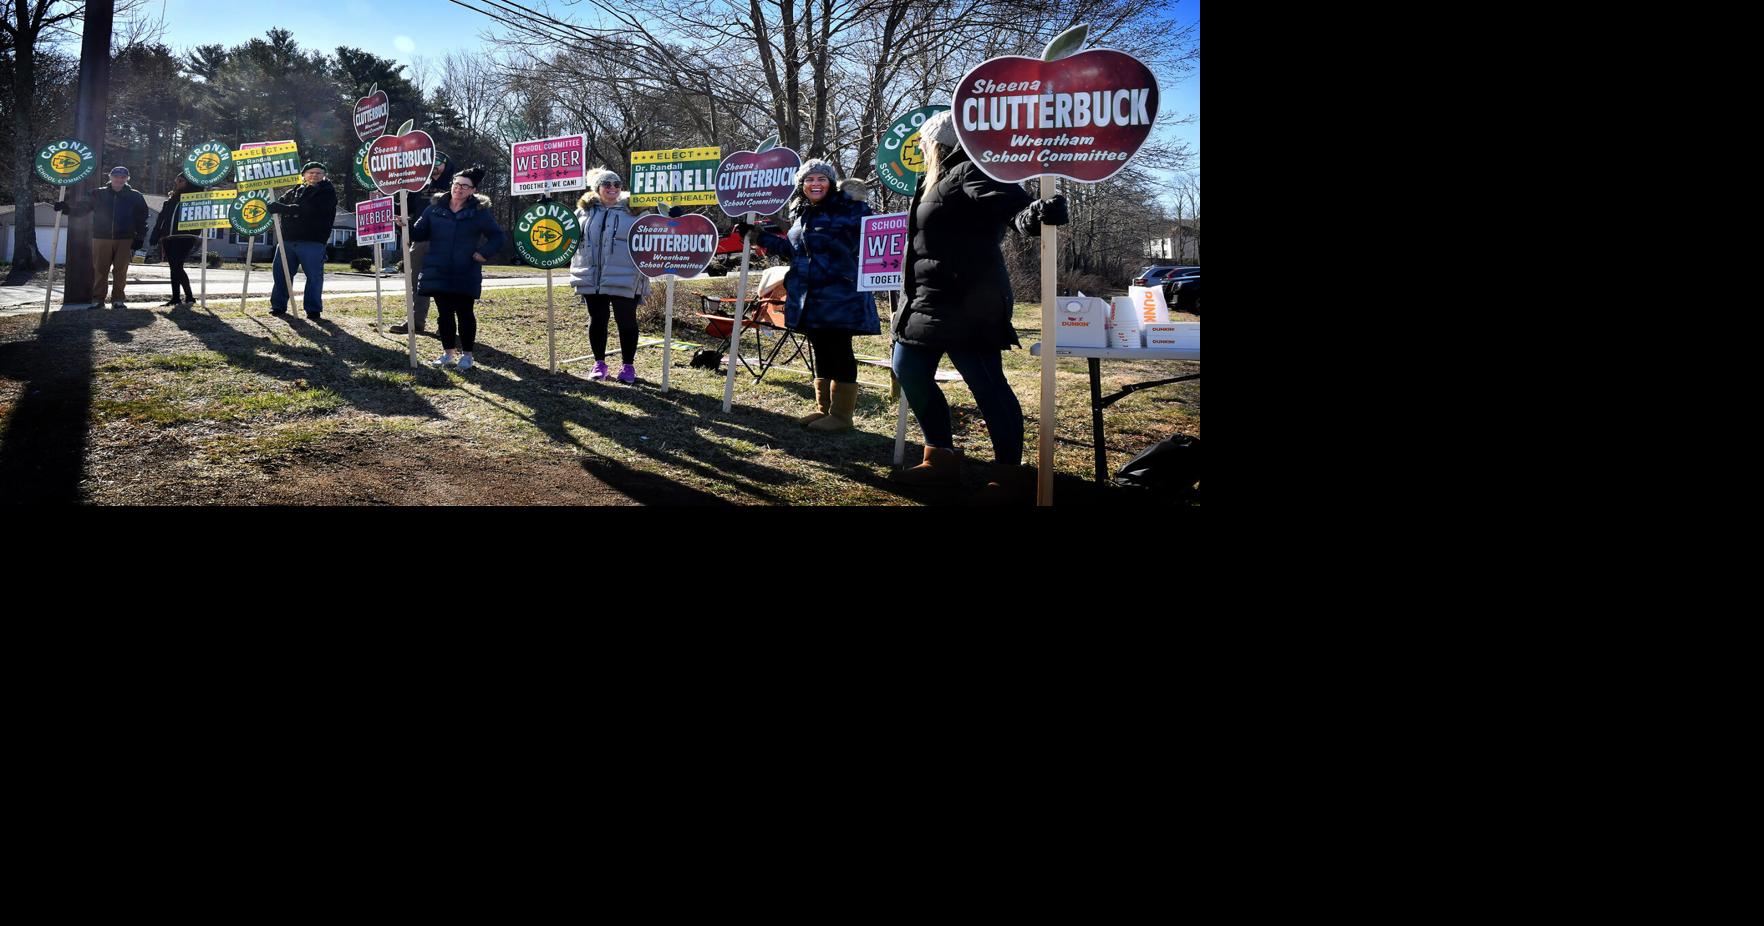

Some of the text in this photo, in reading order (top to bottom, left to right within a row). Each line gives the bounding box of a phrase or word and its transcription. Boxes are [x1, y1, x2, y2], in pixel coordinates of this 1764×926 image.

[972, 78, 1041, 94] Sheena
[356, 102, 387, 126] CLUTTERBUCK
[962, 88, 1150, 132] CLUTTERBUCK
[518, 139, 580, 153] SCHOOL COMMITTEE
[1010, 133, 1095, 147] Wrentham
[41, 141, 93, 160] CRONIN
[188, 143, 230, 162] CRONIN
[250, 146, 278, 156] ELECT
[356, 141, 372, 165] CRO
[373, 146, 398, 155] Sheena
[657, 151, 694, 160] ELECT
[980, 149, 1128, 164] School Committee
[247, 156, 272, 164] Randall
[370, 147, 433, 173] CLUTTERBUCK
[516, 150, 580, 171] WEBBER
[650, 163, 683, 171] Randall
[724, 162, 753, 172] Sheena
[37, 164, 93, 184] SCHOOL COMMITTEE
[236, 158, 299, 182] FERRELL
[879, 162, 910, 192] SCHOOL
[273, 176, 300, 185] HEALTH
[562, 179, 577, 187] CAN!
[634, 168, 716, 194] FERRELL
[718, 166, 797, 191] CLUTTERBUCK
[736, 190, 772, 198] Wrentham
[723, 197, 785, 207] School Committee
[359, 209, 393, 226] WEBBER
[519, 205, 576, 232] CRONIN
[871, 218, 906, 231] SCHOOL
[637, 225, 669, 233] Sheena
[632, 234, 714, 253] CLUTTERBUCK
[516, 239, 578, 266] SCHOOL COMMITTEE
[653, 253, 690, 261] Wrentham
[639, 261, 704, 270] School Committee
[870, 274, 903, 285] TOGET
[1143, 291, 1157, 323] DUNK
